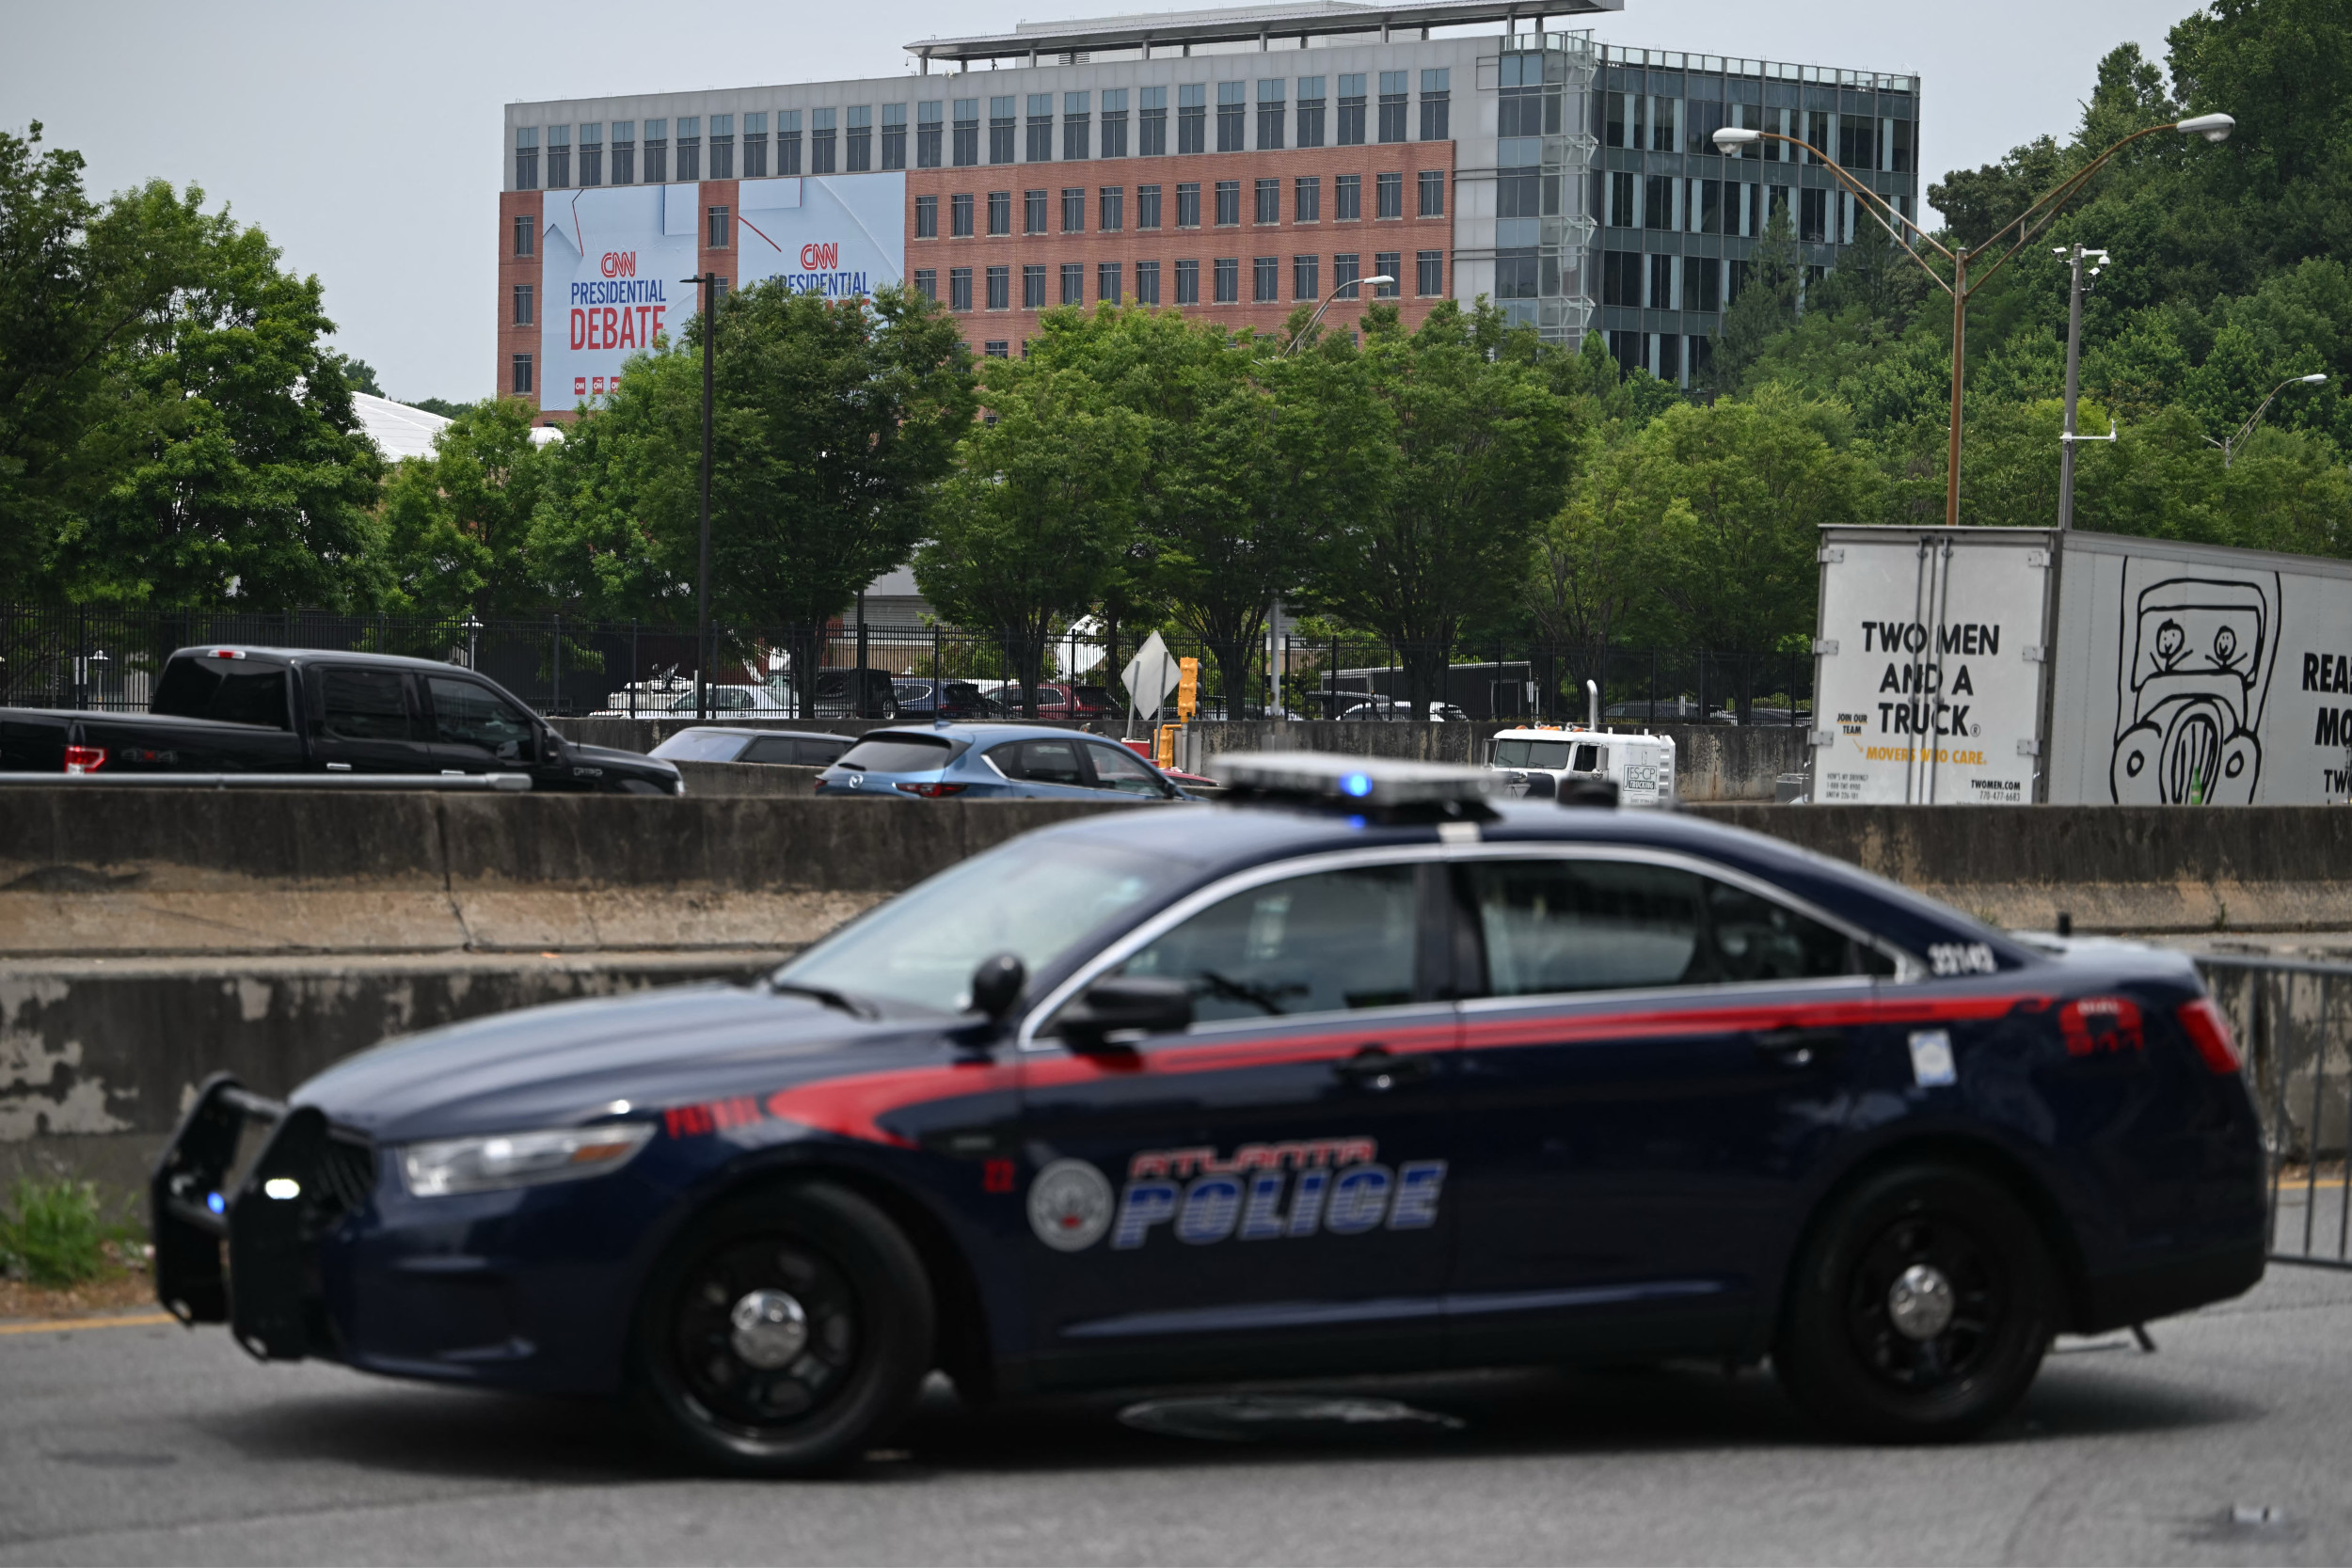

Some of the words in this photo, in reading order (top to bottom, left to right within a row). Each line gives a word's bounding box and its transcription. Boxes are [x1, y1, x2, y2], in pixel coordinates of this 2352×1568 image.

[601, 250, 636, 277] CNN
[801, 242, 838, 271] CNN
[571, 279, 667, 305] PRESIDENTIAL
[570, 306, 666, 350] DEBATE
[1862, 622, 1928, 654] TWO
[1936, 624, 2000, 656] MEN
[1879, 662, 1944, 694] AND
[1951, 664, 1974, 696] A
[2302, 652, 2352, 695] REA
[1837, 713, 1852, 722] JOIN
[1853, 715, 1868, 723] OUR
[1843, 725, 1862, 734] TEAM
[1867, 746, 1915, 763] MOVERS
[1971, 780, 2021, 790] TWOMEN.COM
[1129, 1136, 1378, 1178] ATLANTA
[1109, 1159, 1449, 1250] POLICE
